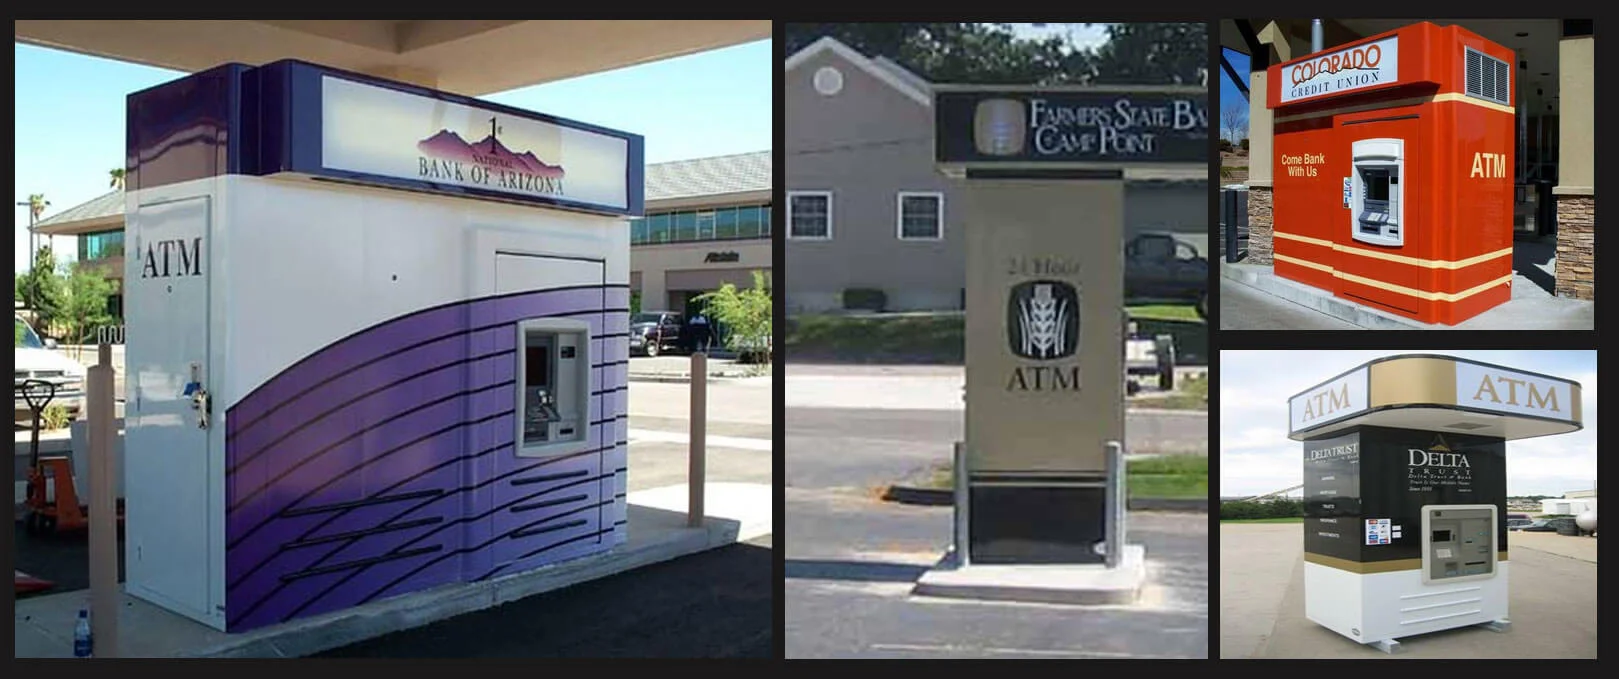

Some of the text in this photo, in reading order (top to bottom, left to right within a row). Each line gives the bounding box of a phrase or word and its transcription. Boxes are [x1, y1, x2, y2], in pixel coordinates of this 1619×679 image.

[1292, 44, 1381, 85] COLORADO
[1291, 72, 1379, 98] CREDIT UNION
[1030, 99, 1209, 130] FARMERS STATE BA
[1035, 125, 1155, 155] CAMP POINT
[1281, 152, 1325, 165] Come Bank
[1287, 166, 1318, 177] With Us
[1470, 152, 1506, 178] ATM
[418, 156, 564, 195] BANK OF ARIZONA
[142, 236, 202, 278] ATM
[1006, 366, 1081, 391] ATM
[1473, 374, 1560, 412] ATM
[1302, 383, 1351, 422] ATM
[1408, 448, 1470, 468] DELTA
